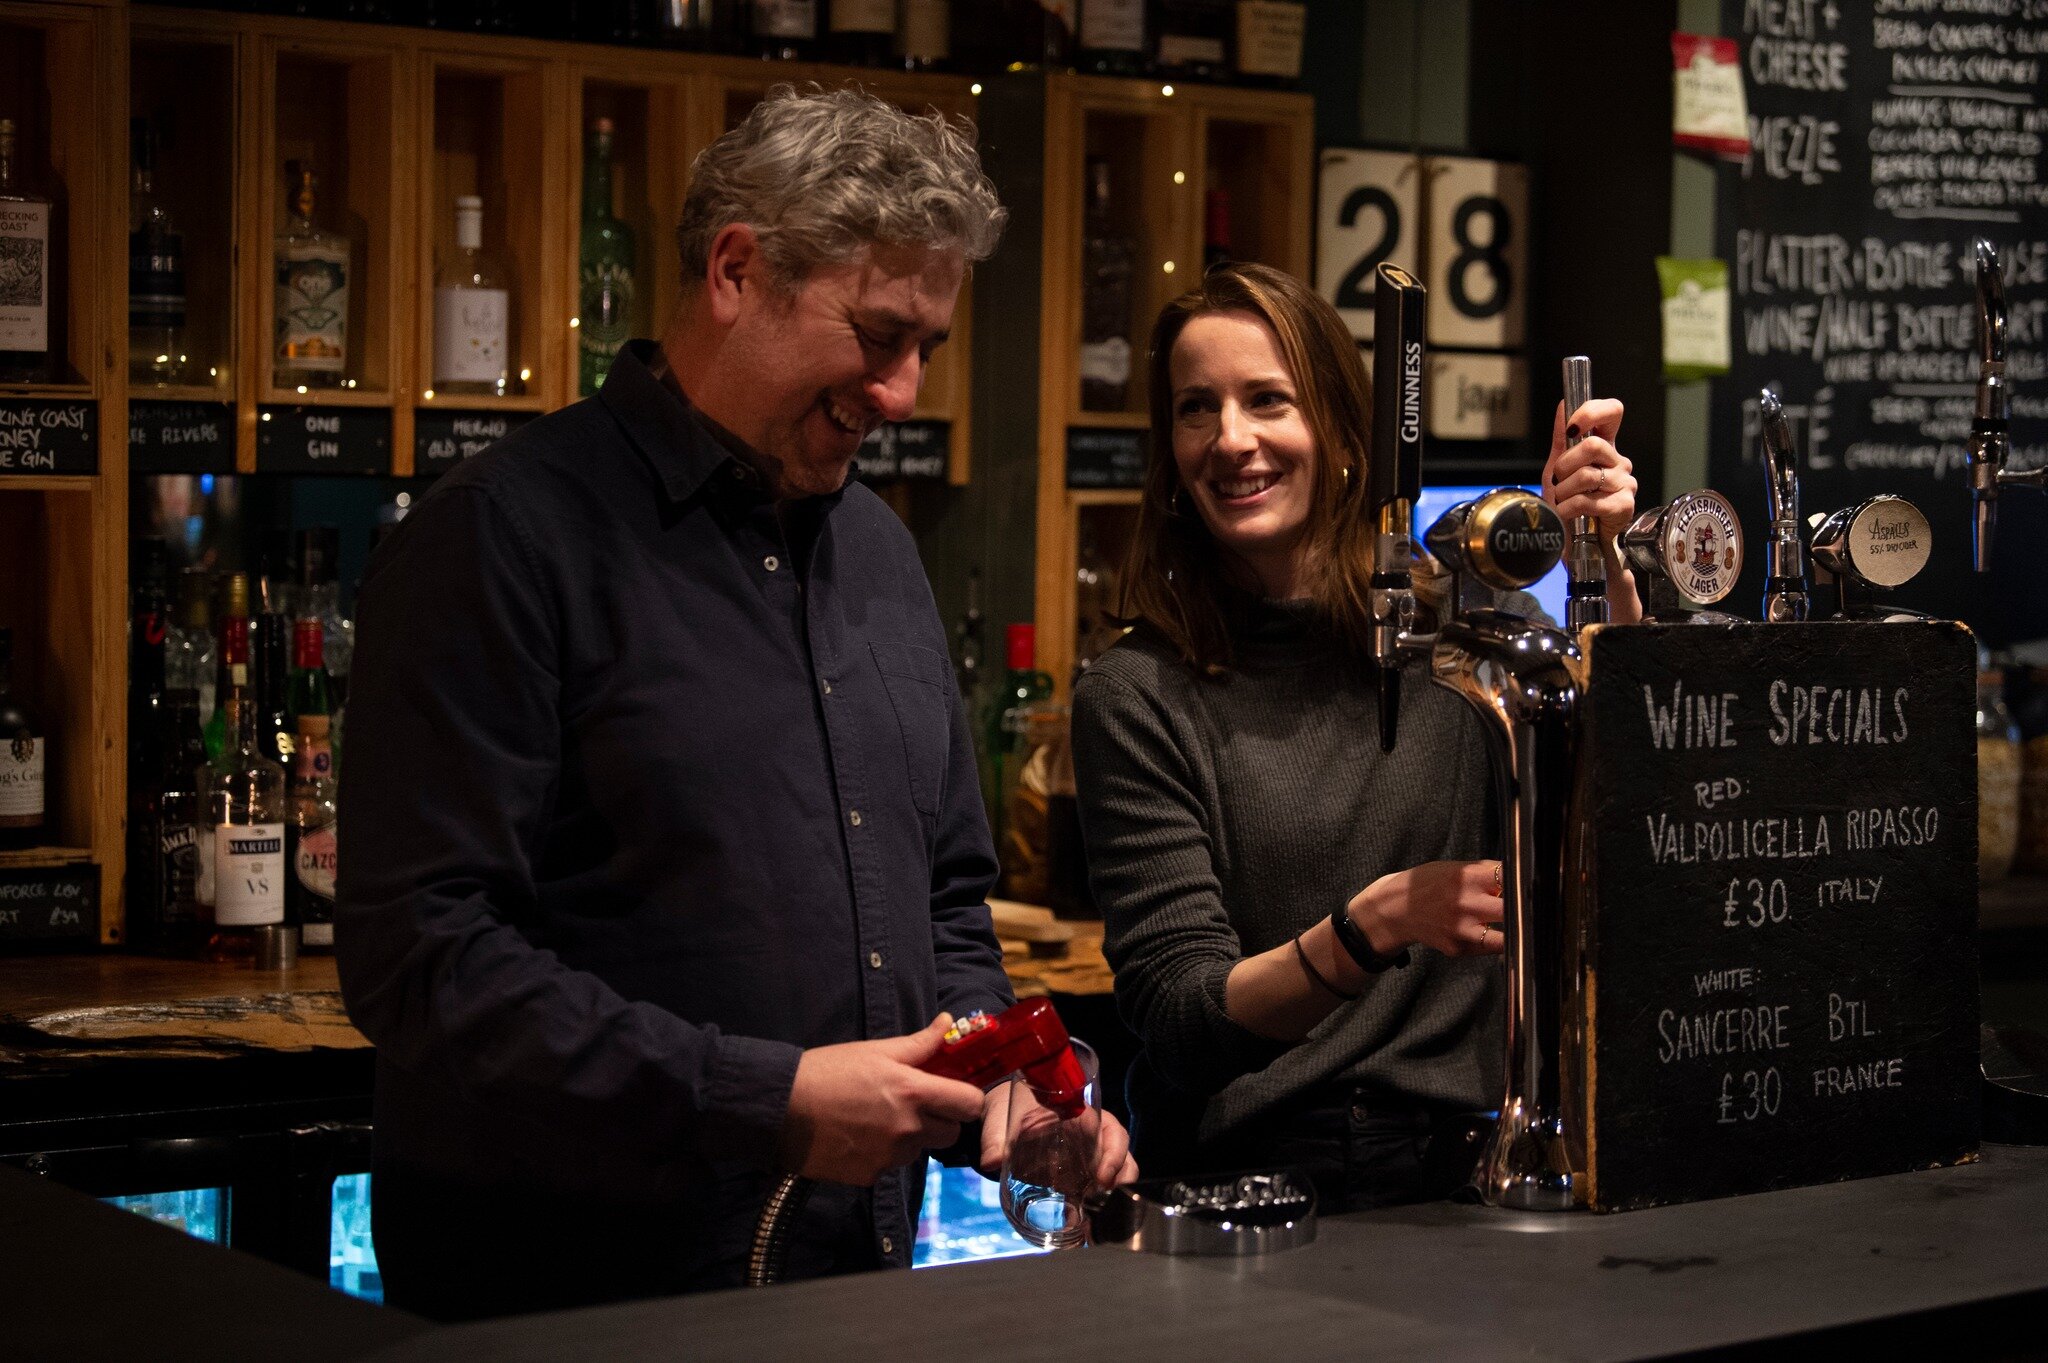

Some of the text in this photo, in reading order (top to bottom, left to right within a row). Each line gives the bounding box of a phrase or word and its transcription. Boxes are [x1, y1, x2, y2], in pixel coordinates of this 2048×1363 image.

[1749, 34, 1850, 91] CHEESE
[1400, 342, 1422, 444] GUINNESS
[40, 406, 87, 431] COAST
[305, 416, 340, 434] ONE
[20, 450, 55, 470] GIN
[307, 439, 340, 460] GIN
[1677, 499, 1735, 540] FLENSBURGER
[1494, 529, 1562, 553] GUINNESS
[1689, 574, 1719, 594] LAGER
[1643, 678, 1910, 750] WINE SPECIALS
[1646, 805, 1939, 864] VALPOLICELLA RIPASSO
[246, 877, 269, 896] VS
[1818, 875, 1884, 907] ITALY
[1657, 1003, 1791, 1064] SANCERRE
[1716, 1057, 1905, 1125] £30 FRANCE
